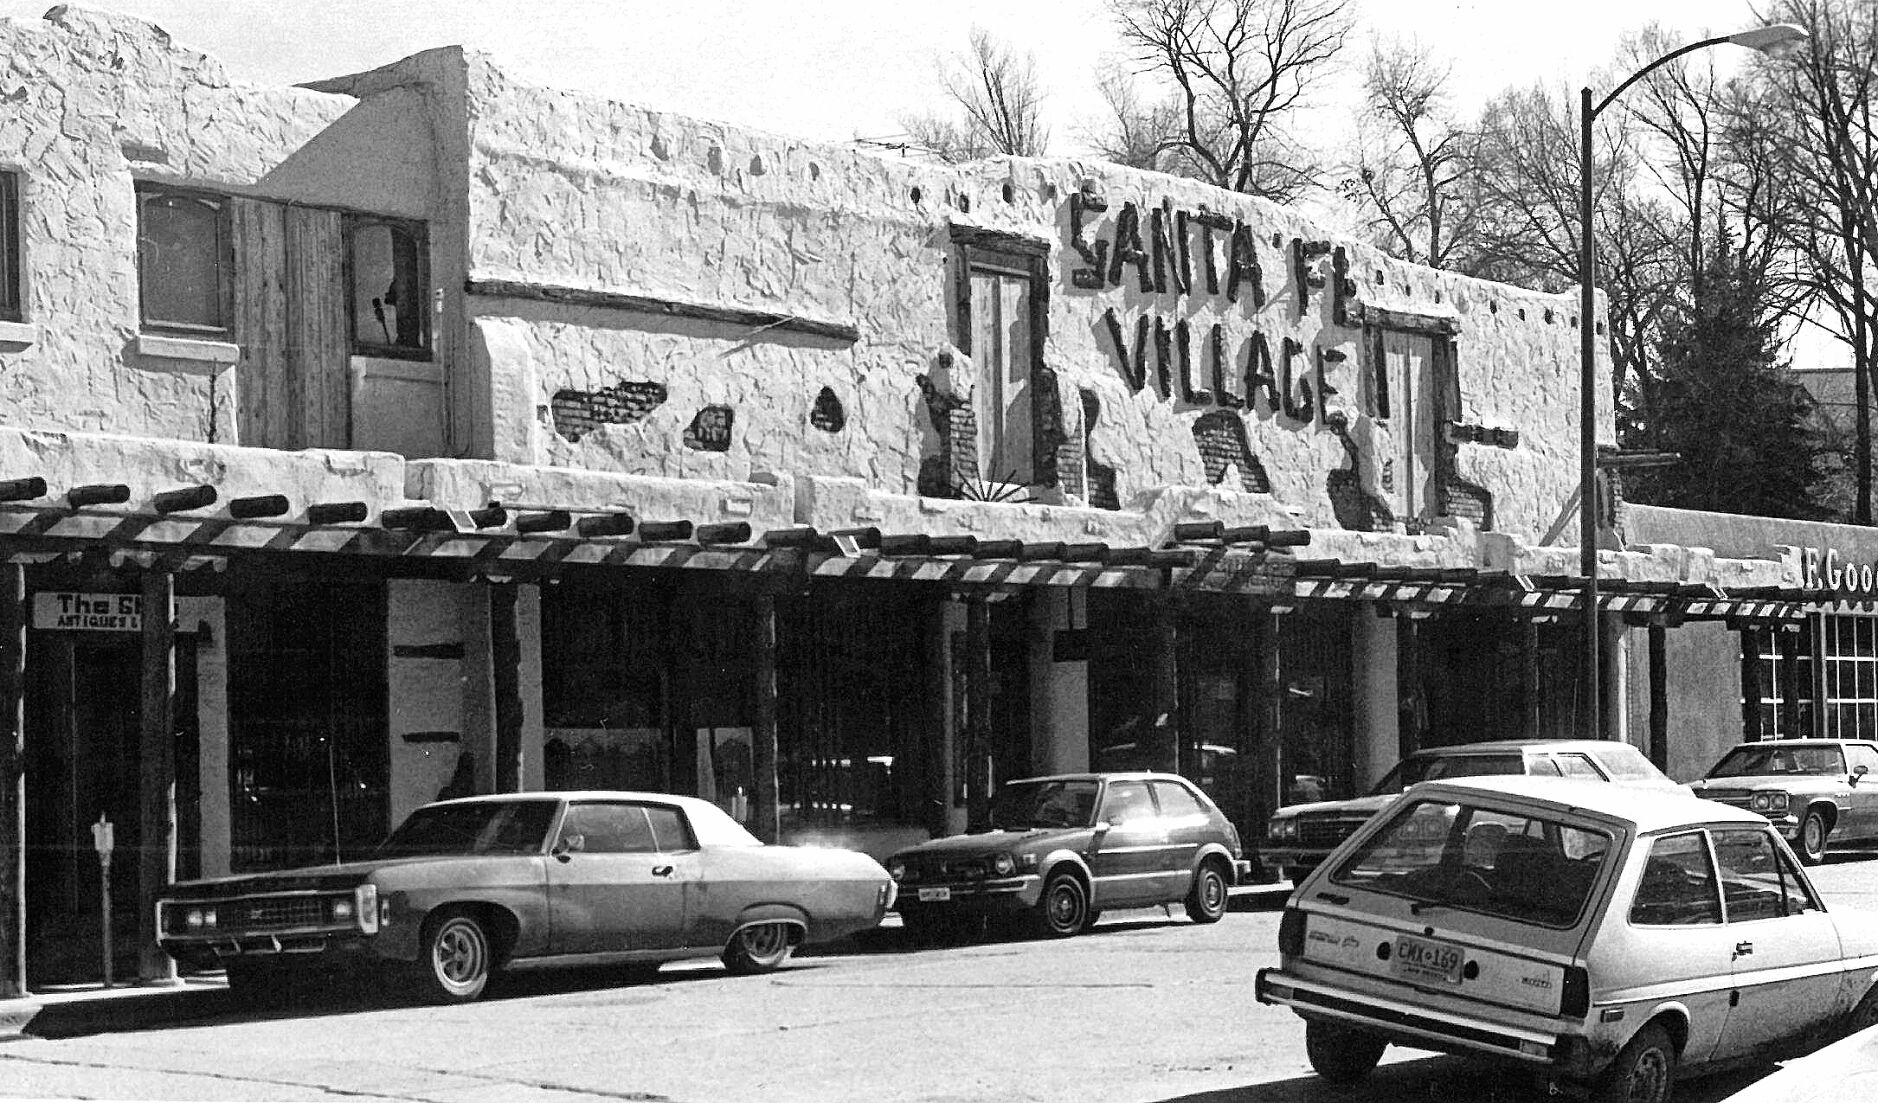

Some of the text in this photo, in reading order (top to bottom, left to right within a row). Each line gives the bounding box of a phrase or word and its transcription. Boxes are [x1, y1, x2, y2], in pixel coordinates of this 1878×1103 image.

[1071, 178, 1363, 328] SANTA FE
[1104, 306, 1347, 428] VILLAGE
[57, 593, 110, 614] The
